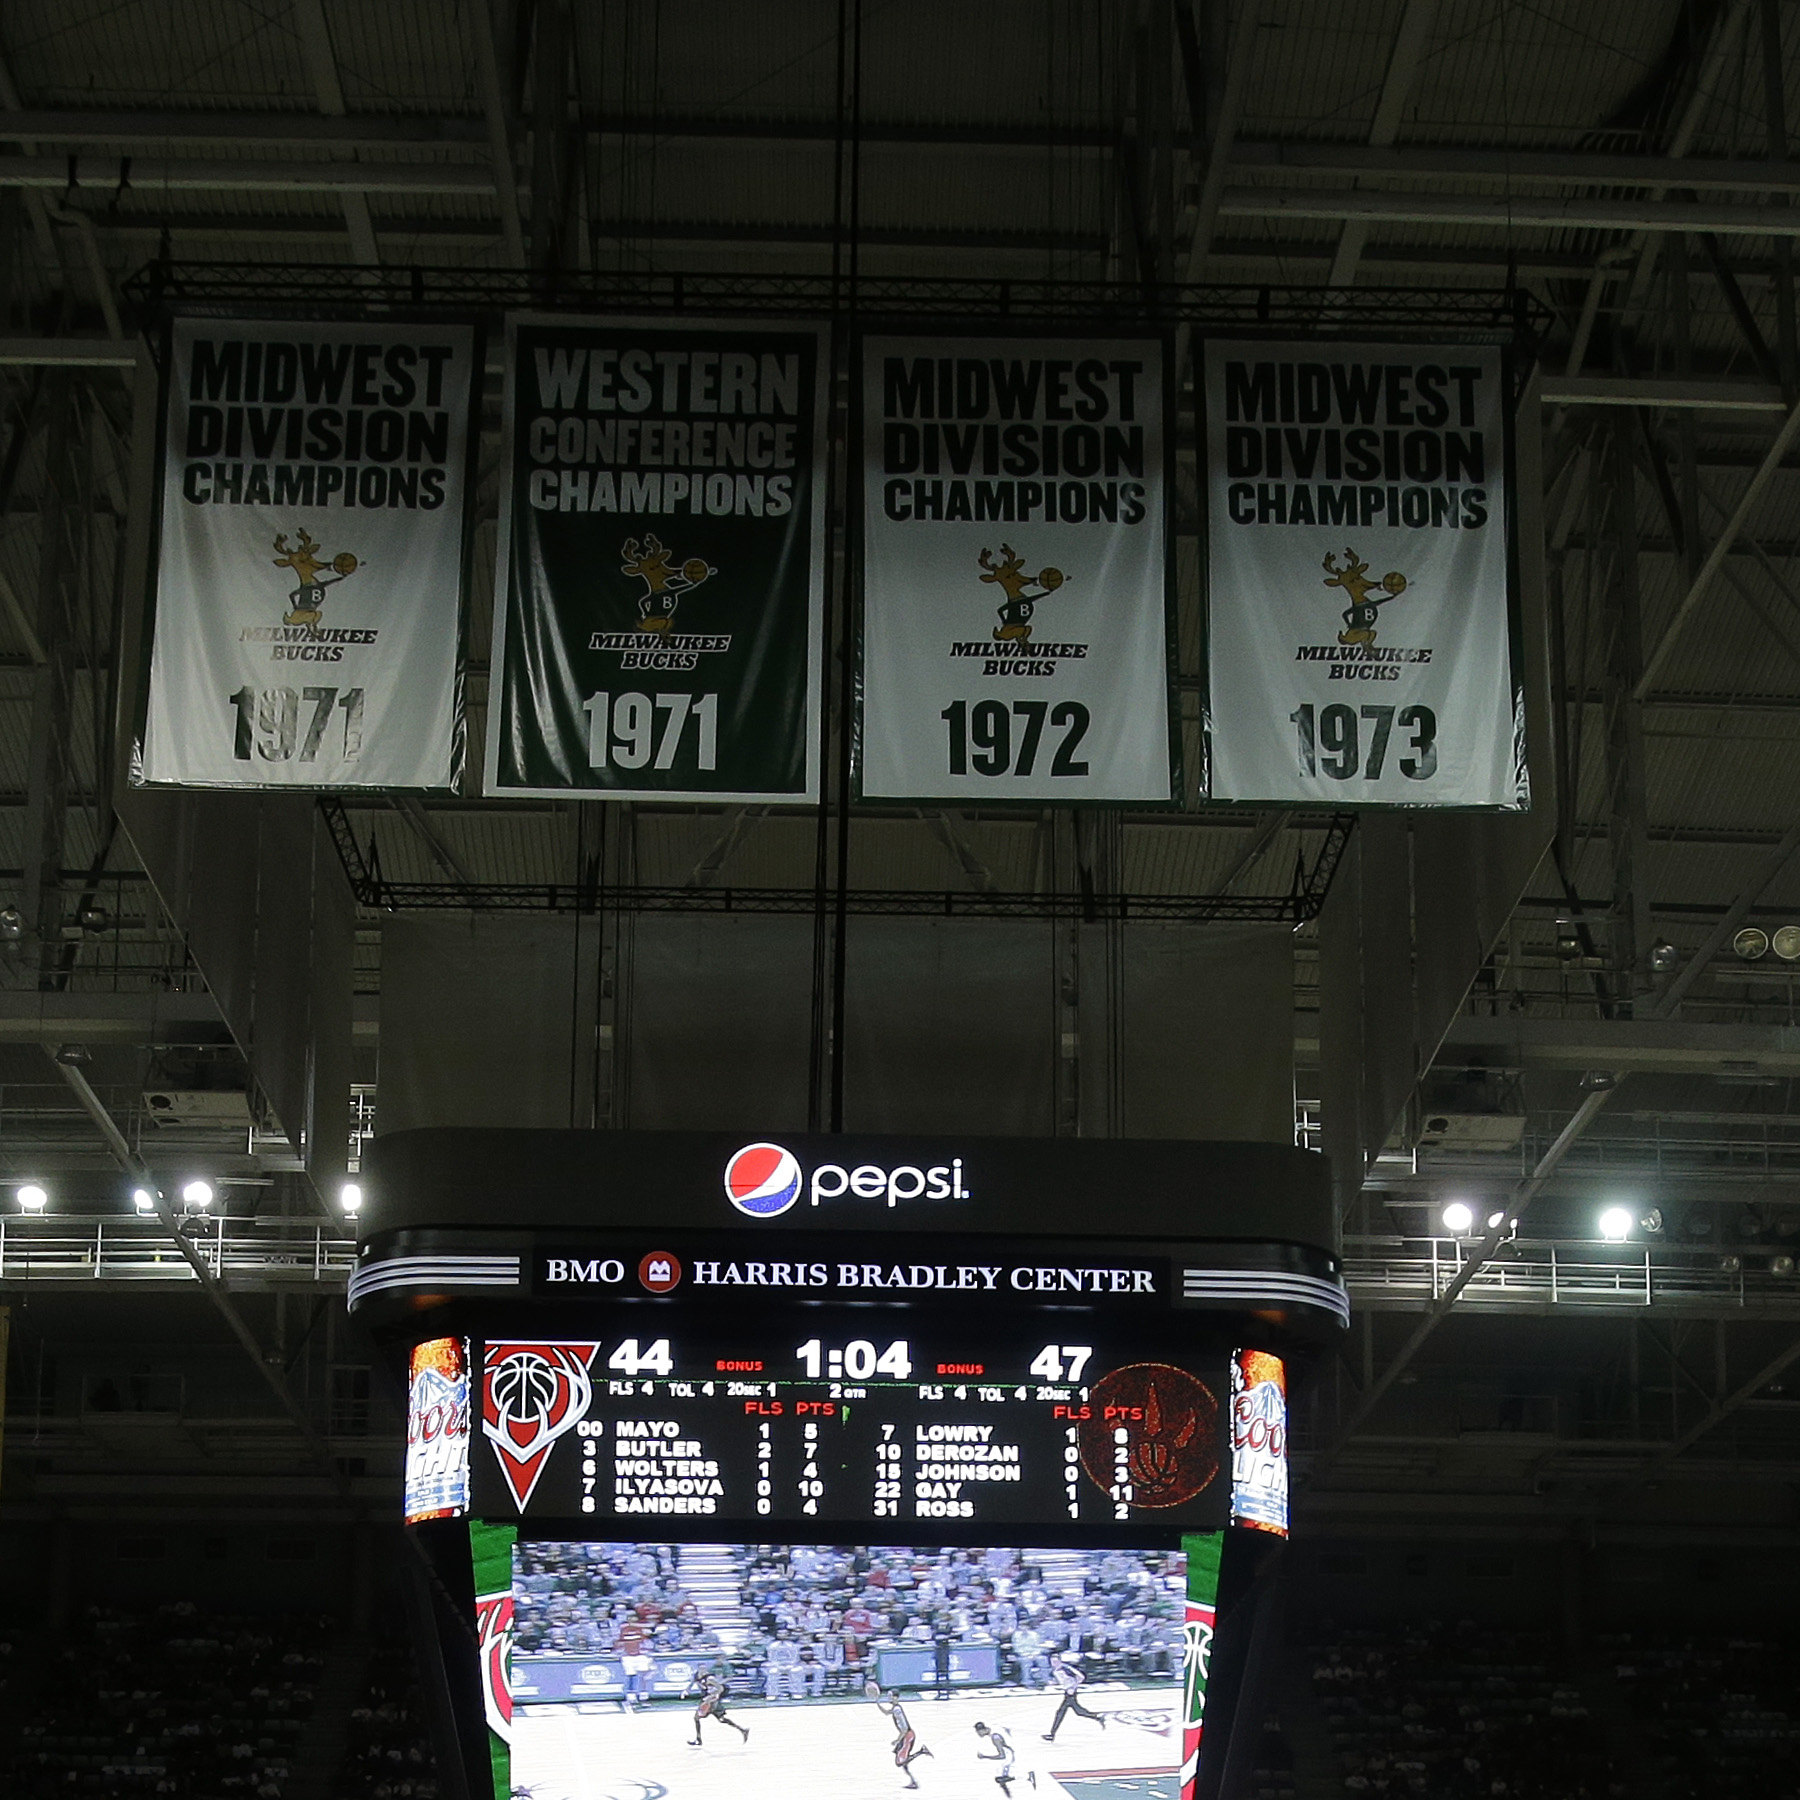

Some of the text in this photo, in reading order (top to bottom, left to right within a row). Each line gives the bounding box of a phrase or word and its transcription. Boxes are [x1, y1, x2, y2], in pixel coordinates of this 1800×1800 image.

[192, 340, 453, 408] MIDWEST
[534, 347, 799, 415] WESTERN
[883, 358, 1143, 422] MIDWEST
[1226, 362, 1481, 428] MIDWEST
[186, 406, 448, 463] DIVISION
[529, 417, 797, 469] CONFERENCE
[883, 424, 1144, 478] DIVISION
[1227, 428, 1484, 484] DIVISION
[182, 463, 445, 510] CHAMPIONS
[529, 469, 794, 517] CHAMPIONS
[882, 480, 1146, 525] CHAMPIONS
[1228, 484, 1488, 529] CHAMPIONS
[271, 645, 344, 662] BUCKS
[621, 652, 698, 670] BUCKS
[950, 641, 1088, 658] MILWAUKEE
[982, 660, 1056, 676] BUCKS
[1328, 665, 1400, 681] BUCKS
[230, 685, 365, 762] 1971
[584, 692, 718, 770] 1971
[941, 700, 1091, 776] 1972
[1289, 703, 1439, 780] 1973
[811, 1158, 969, 1207] pepsi
[546, 1258, 1156, 1293] BMO HARRIS BRADLEY CENTER
[608, 1339, 1093, 1381] 44 BONUS 1:04 BONUS 47
[744, 1402, 834, 1415] FLS PTS
[1053, 1406, 1143, 1420] FLS PTS
[616, 1421, 679, 1438] MAYO
[916, 1425, 993, 1443] LOWRY
[615, 1441, 701, 1458] BUTLER
[615, 1460, 719, 1477] WOLTERS
[915, 1444, 1019, 1462] DEROZAN
[614, 1479, 723, 1496] ILYASOVA
[915, 1463, 1021, 1481] JOHNSON
[915, 1482, 962, 1500] GAY
[614, 1497, 716, 1514] SANDERS
[915, 1500, 974, 1518] ROSS
